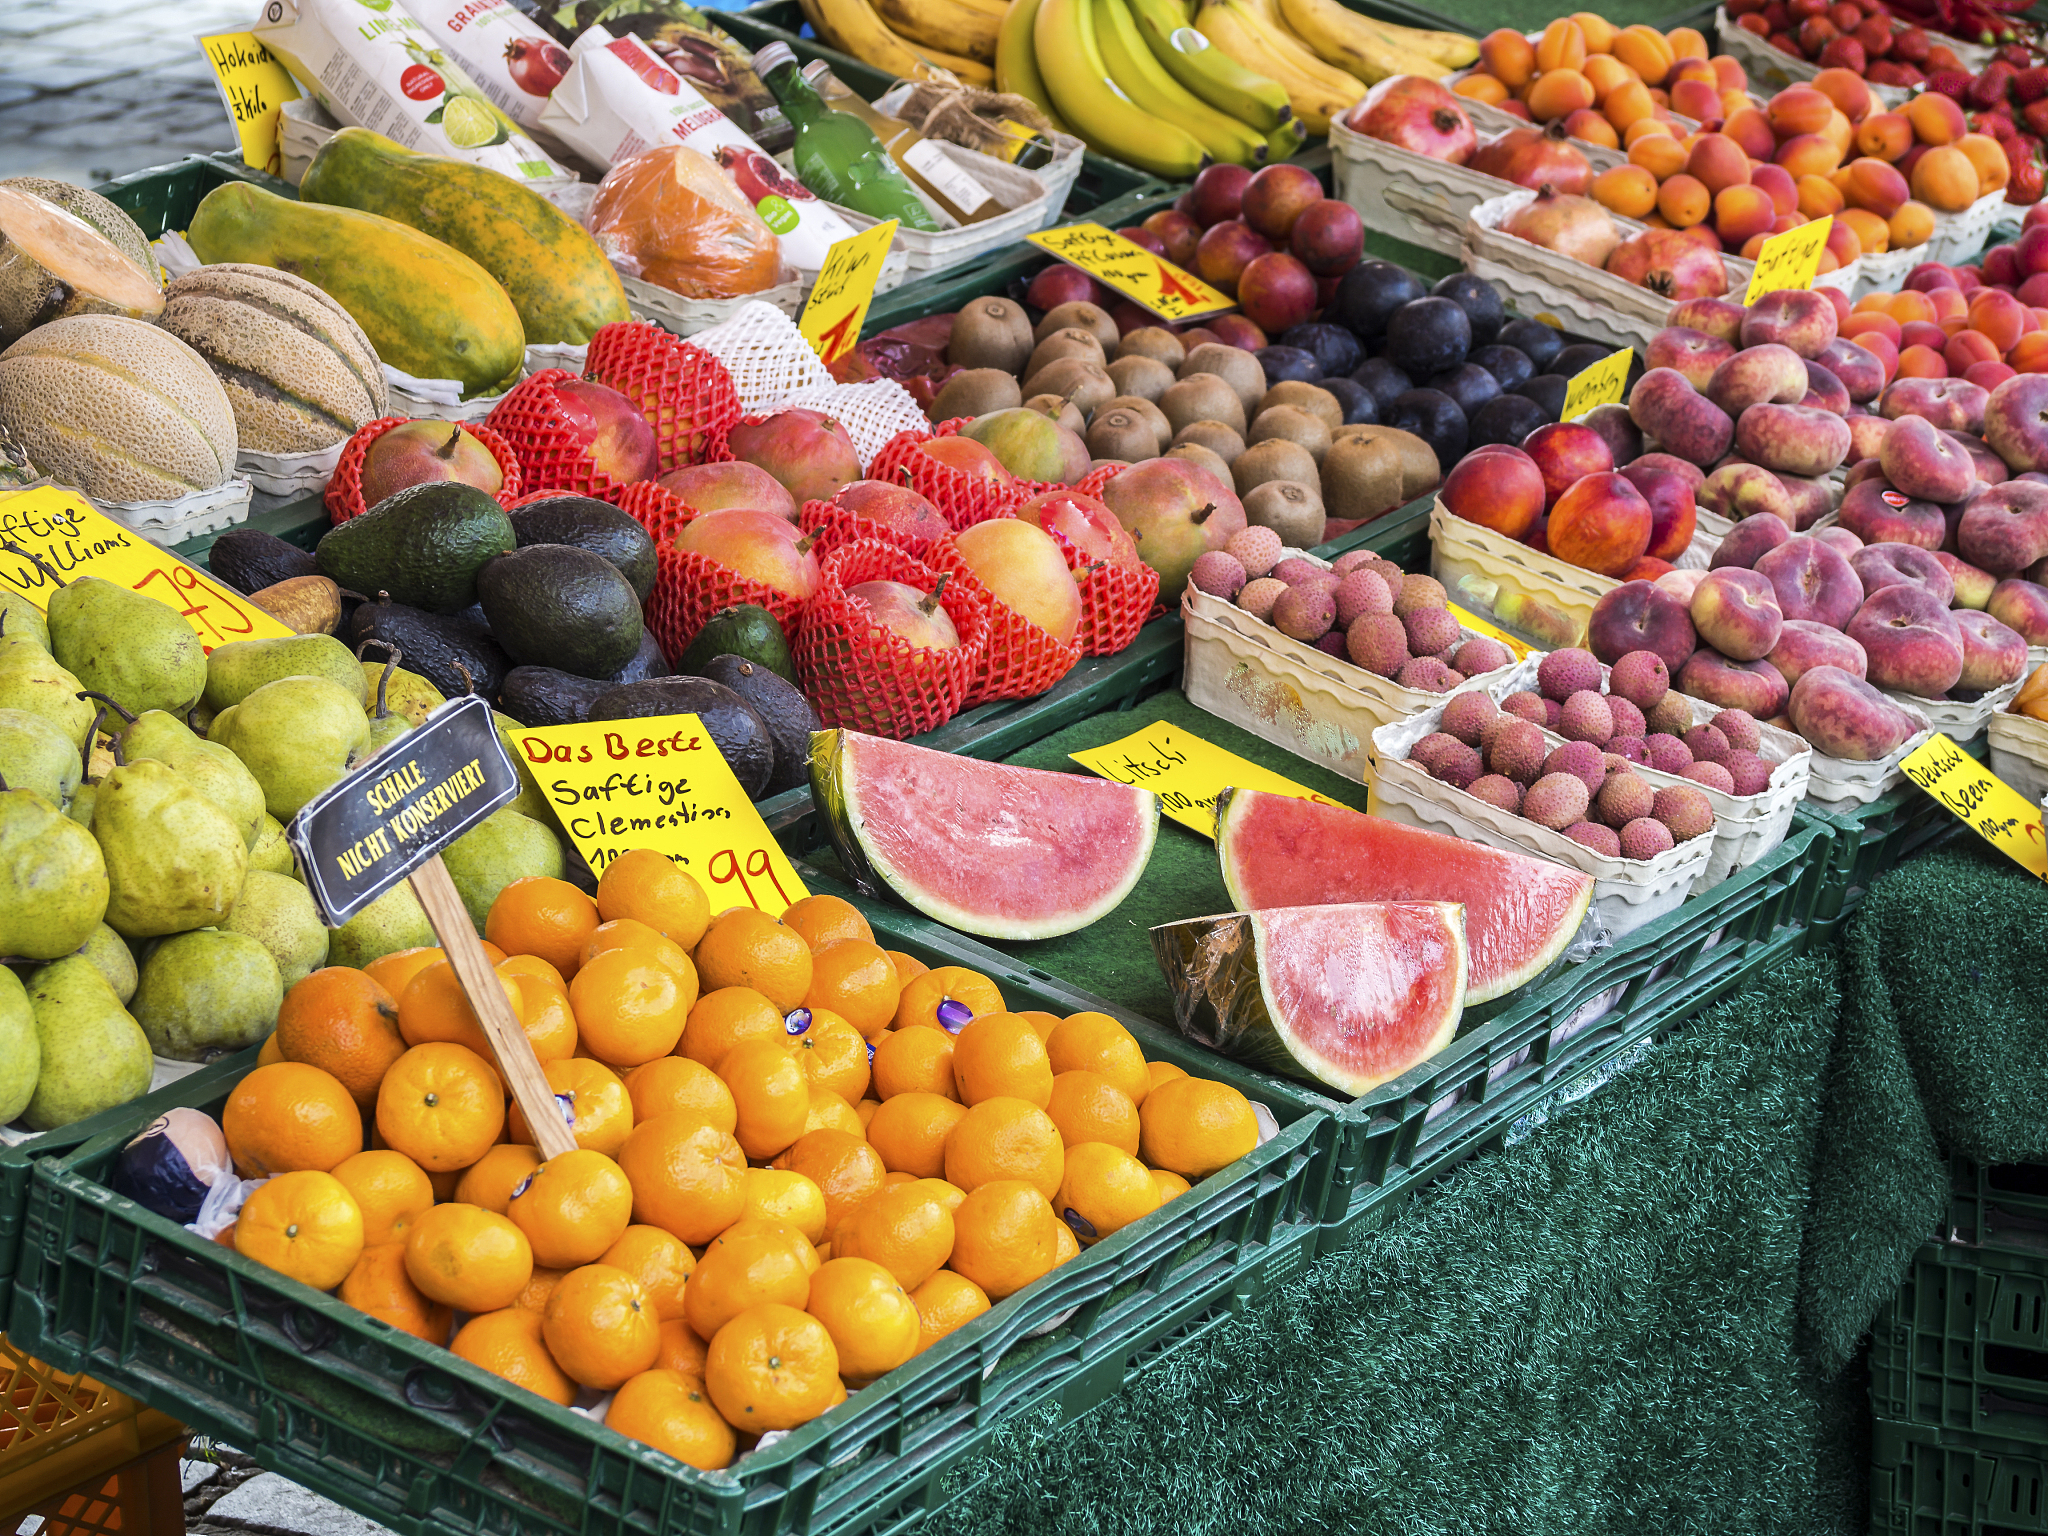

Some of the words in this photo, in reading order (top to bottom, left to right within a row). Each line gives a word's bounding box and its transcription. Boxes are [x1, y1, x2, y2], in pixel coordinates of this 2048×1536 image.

[522, 737, 593, 763] Das
[604, 731, 701, 760] Beste
[366, 760, 426, 816] SCHALE
[552, 773, 691, 805] Saftige
[336, 827, 392, 881] NICHT
[389, 758, 486, 843] KONSERVIERT
[709, 849, 793, 912] 99
